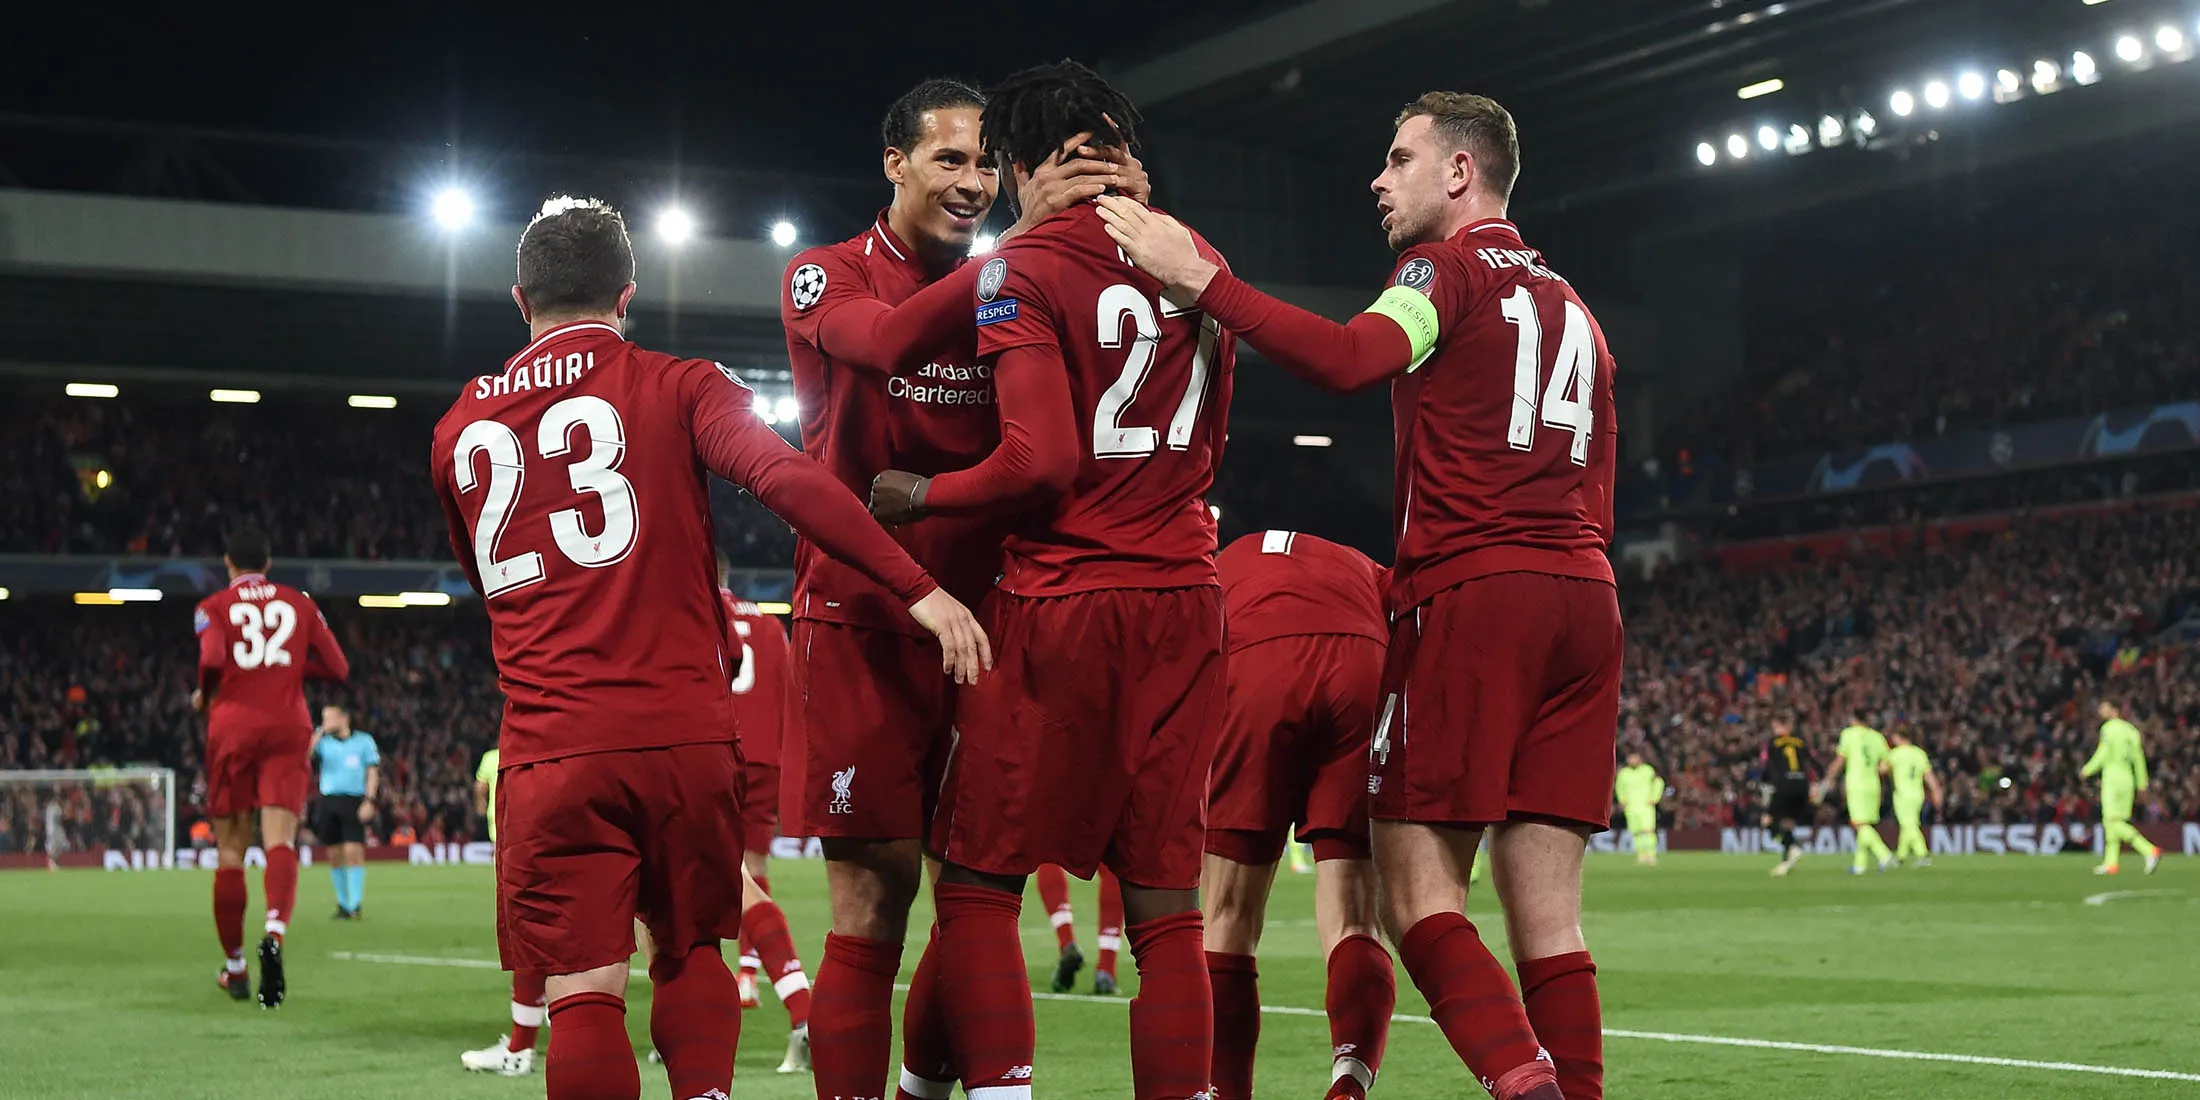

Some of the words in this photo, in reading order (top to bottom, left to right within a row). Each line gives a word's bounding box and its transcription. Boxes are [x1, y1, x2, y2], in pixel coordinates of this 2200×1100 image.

[1407, 272, 1418, 282] 5
[977, 303, 1018, 321] RESPECT
[1399, 302, 1432, 348] RESPECT
[475, 352, 595, 400] SHAQIRI
[887, 376, 990, 405] Chartered
[1093, 284, 1222, 459] 27
[1500, 284, 1597, 467] 14
[453, 396, 640, 600] 23
[229, 600, 298, 670] 32
